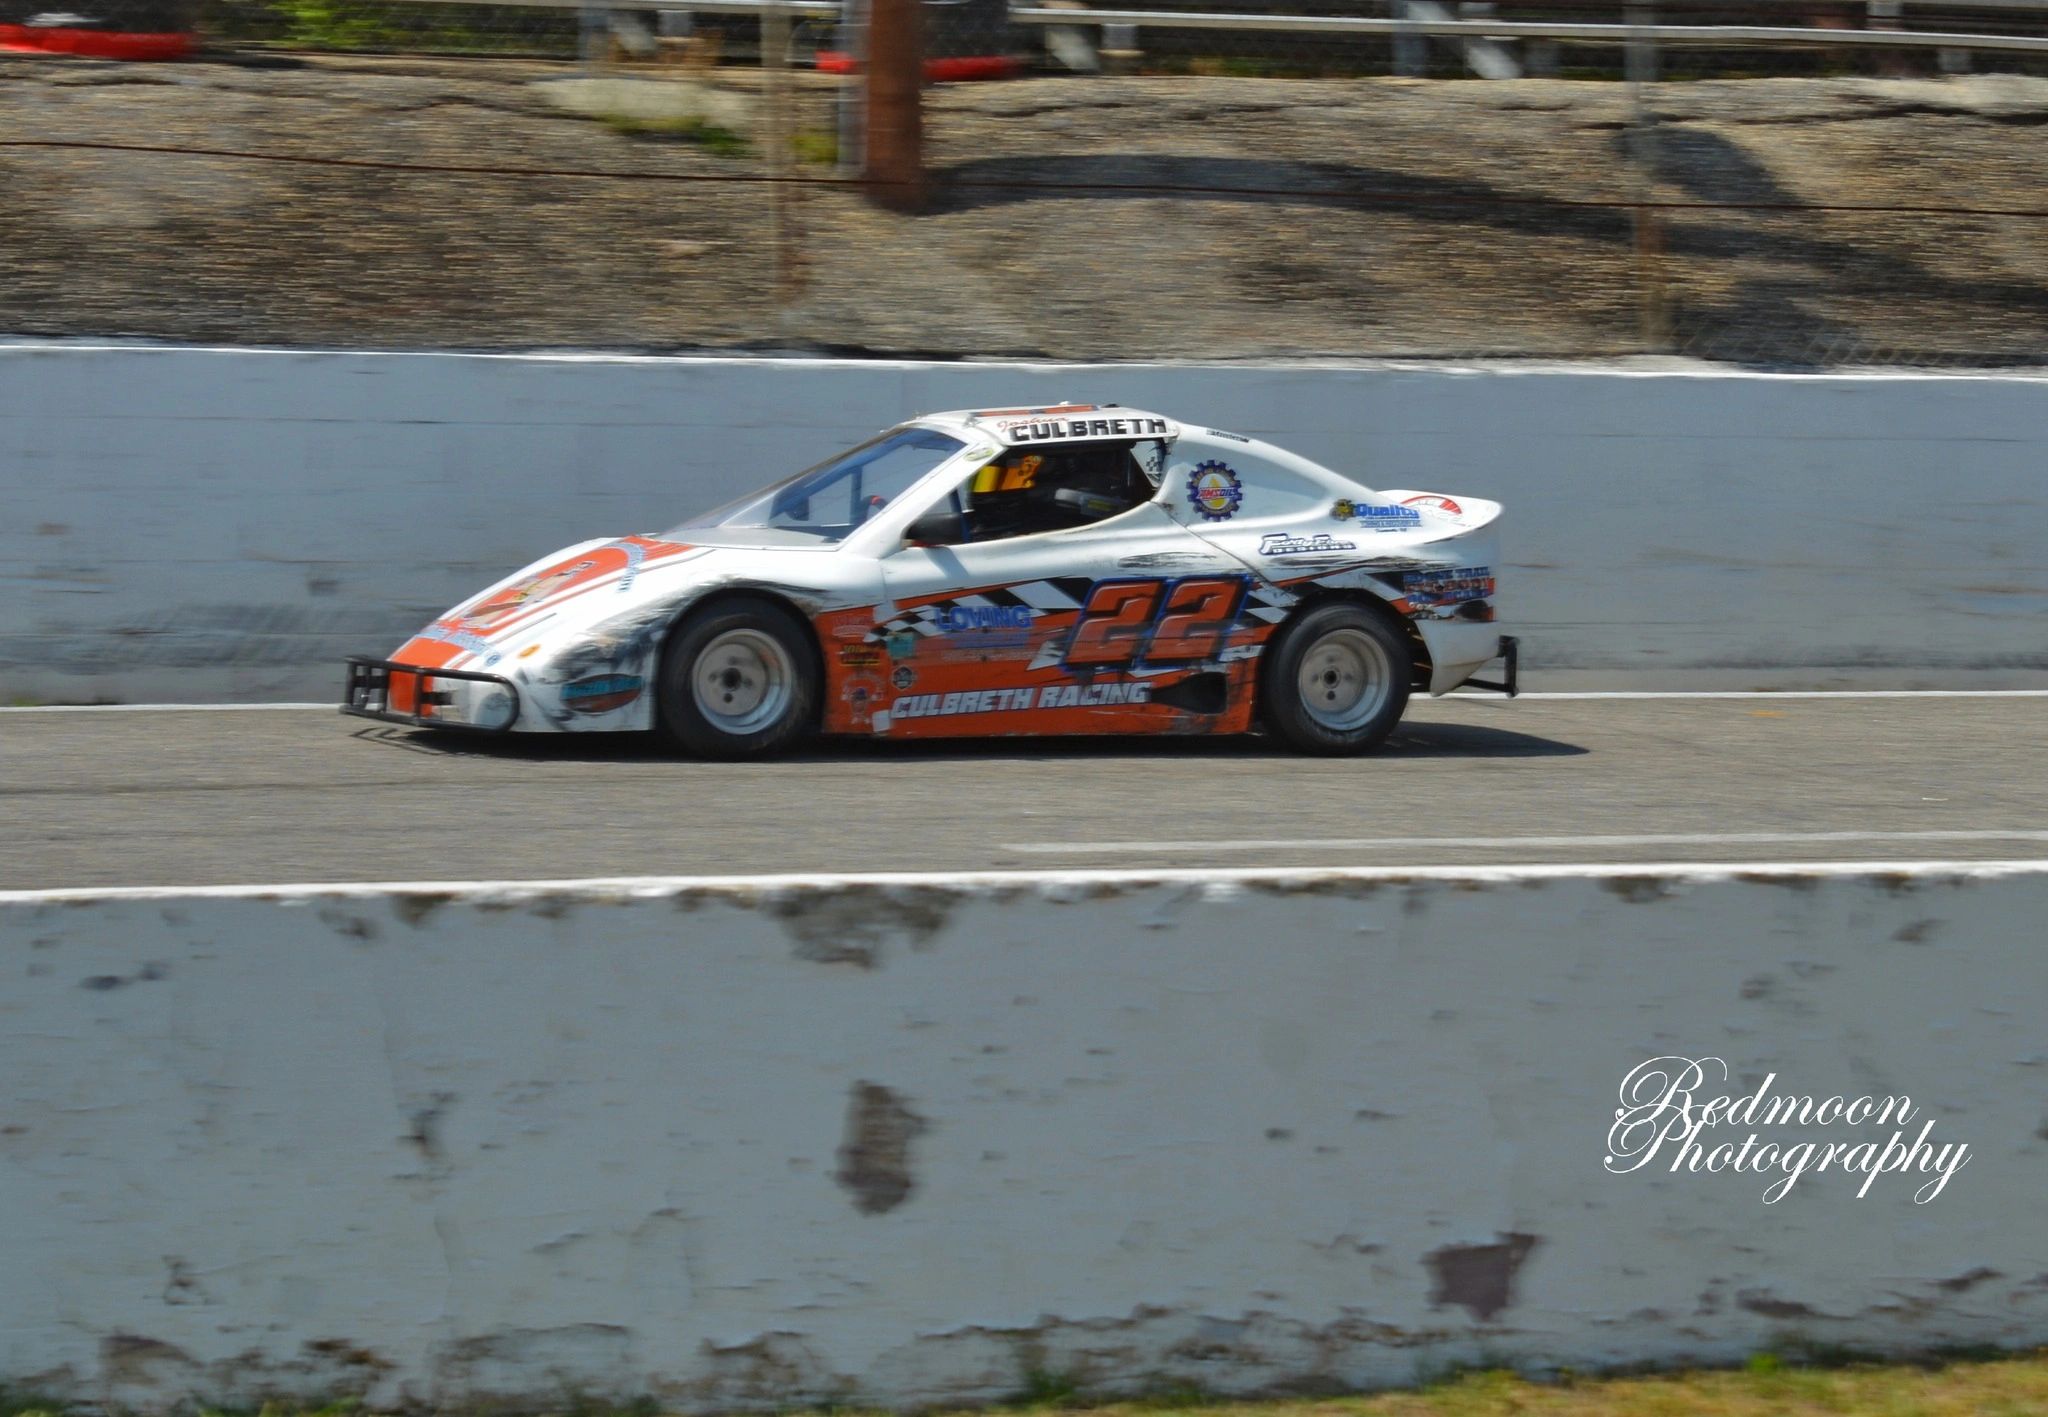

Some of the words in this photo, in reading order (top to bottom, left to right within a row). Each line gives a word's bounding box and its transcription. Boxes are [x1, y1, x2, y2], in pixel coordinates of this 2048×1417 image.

[1009, 418, 1167, 442] CULBRETH
[1198, 487, 1237, 500] AMSOIL
[1356, 503, 1420, 518] Quality
[1062, 576, 1248, 670] 22
[892, 687, 1035, 719] CULBRETH
[1037, 681, 1152, 709] RACING
